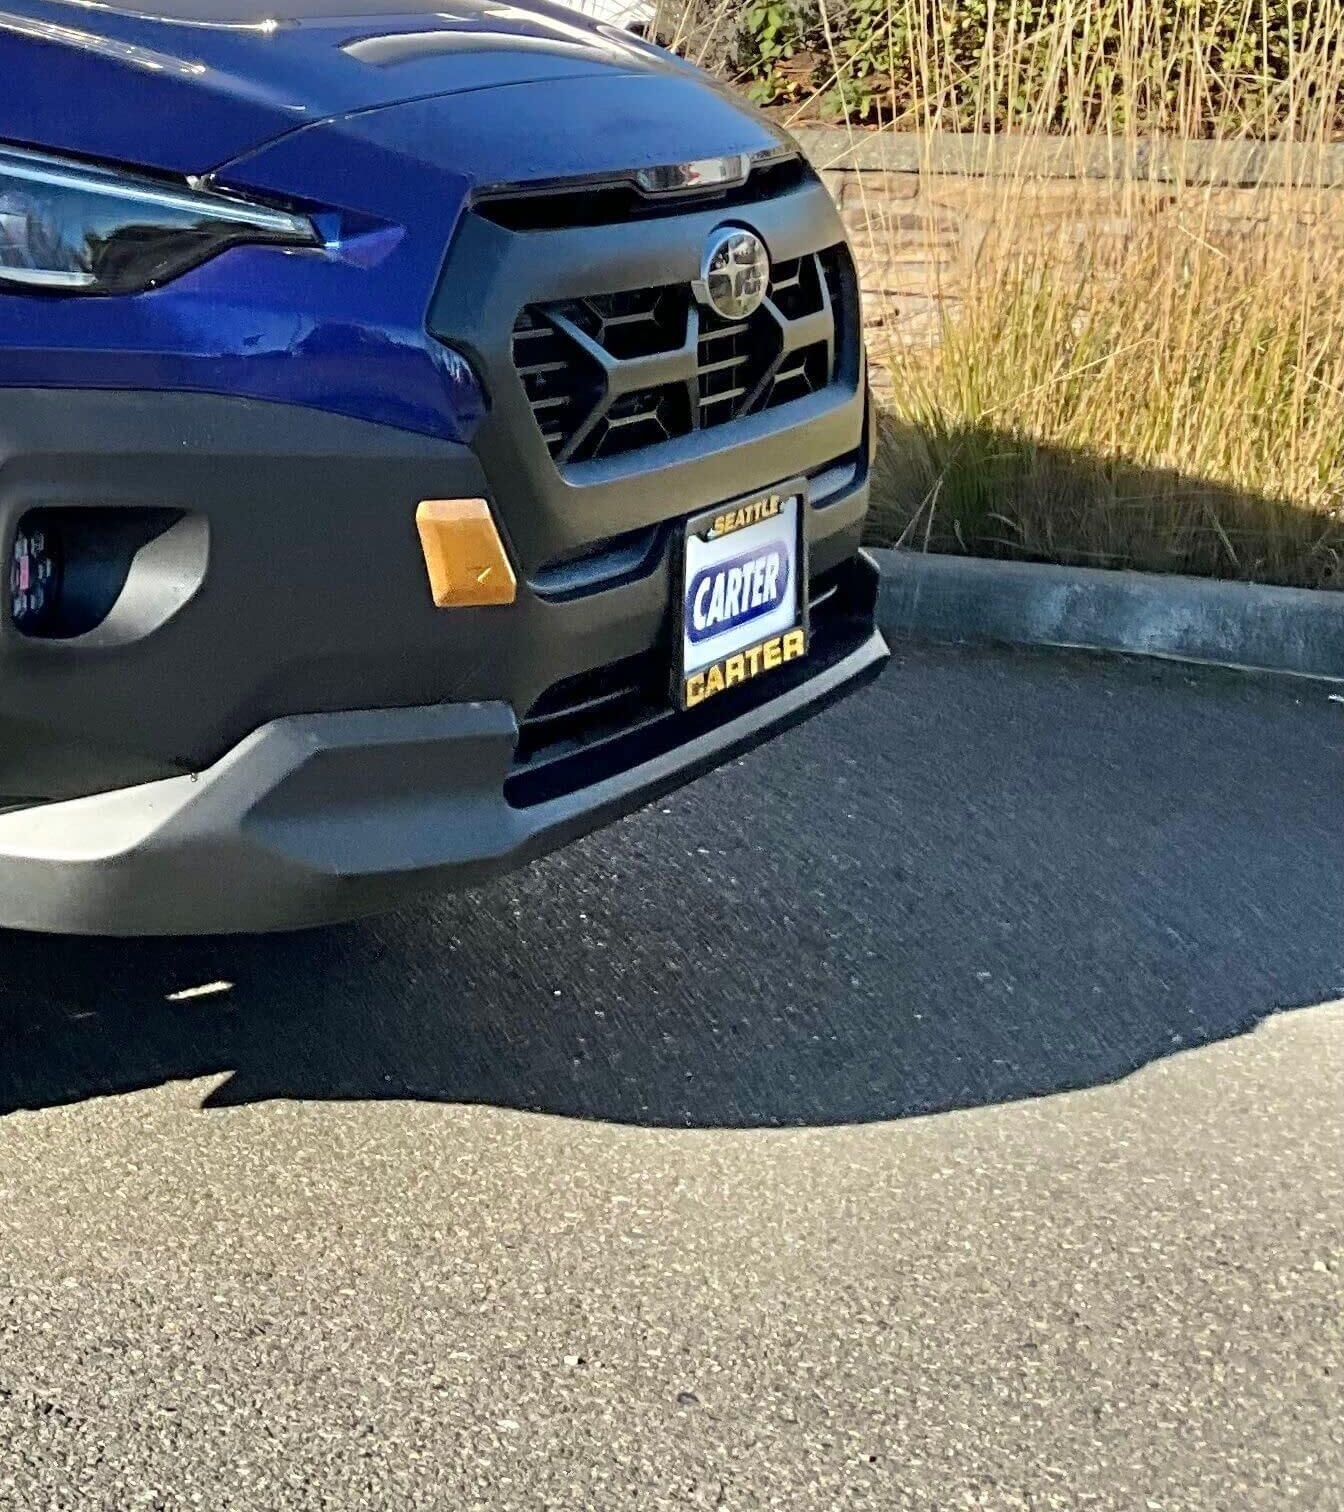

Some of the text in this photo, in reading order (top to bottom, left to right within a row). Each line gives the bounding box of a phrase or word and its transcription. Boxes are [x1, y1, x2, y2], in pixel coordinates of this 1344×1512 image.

[713, 494, 782, 538] SEATTLE
[692, 551, 781, 632] CARTER
[685, 628, 806, 709] CARTER
